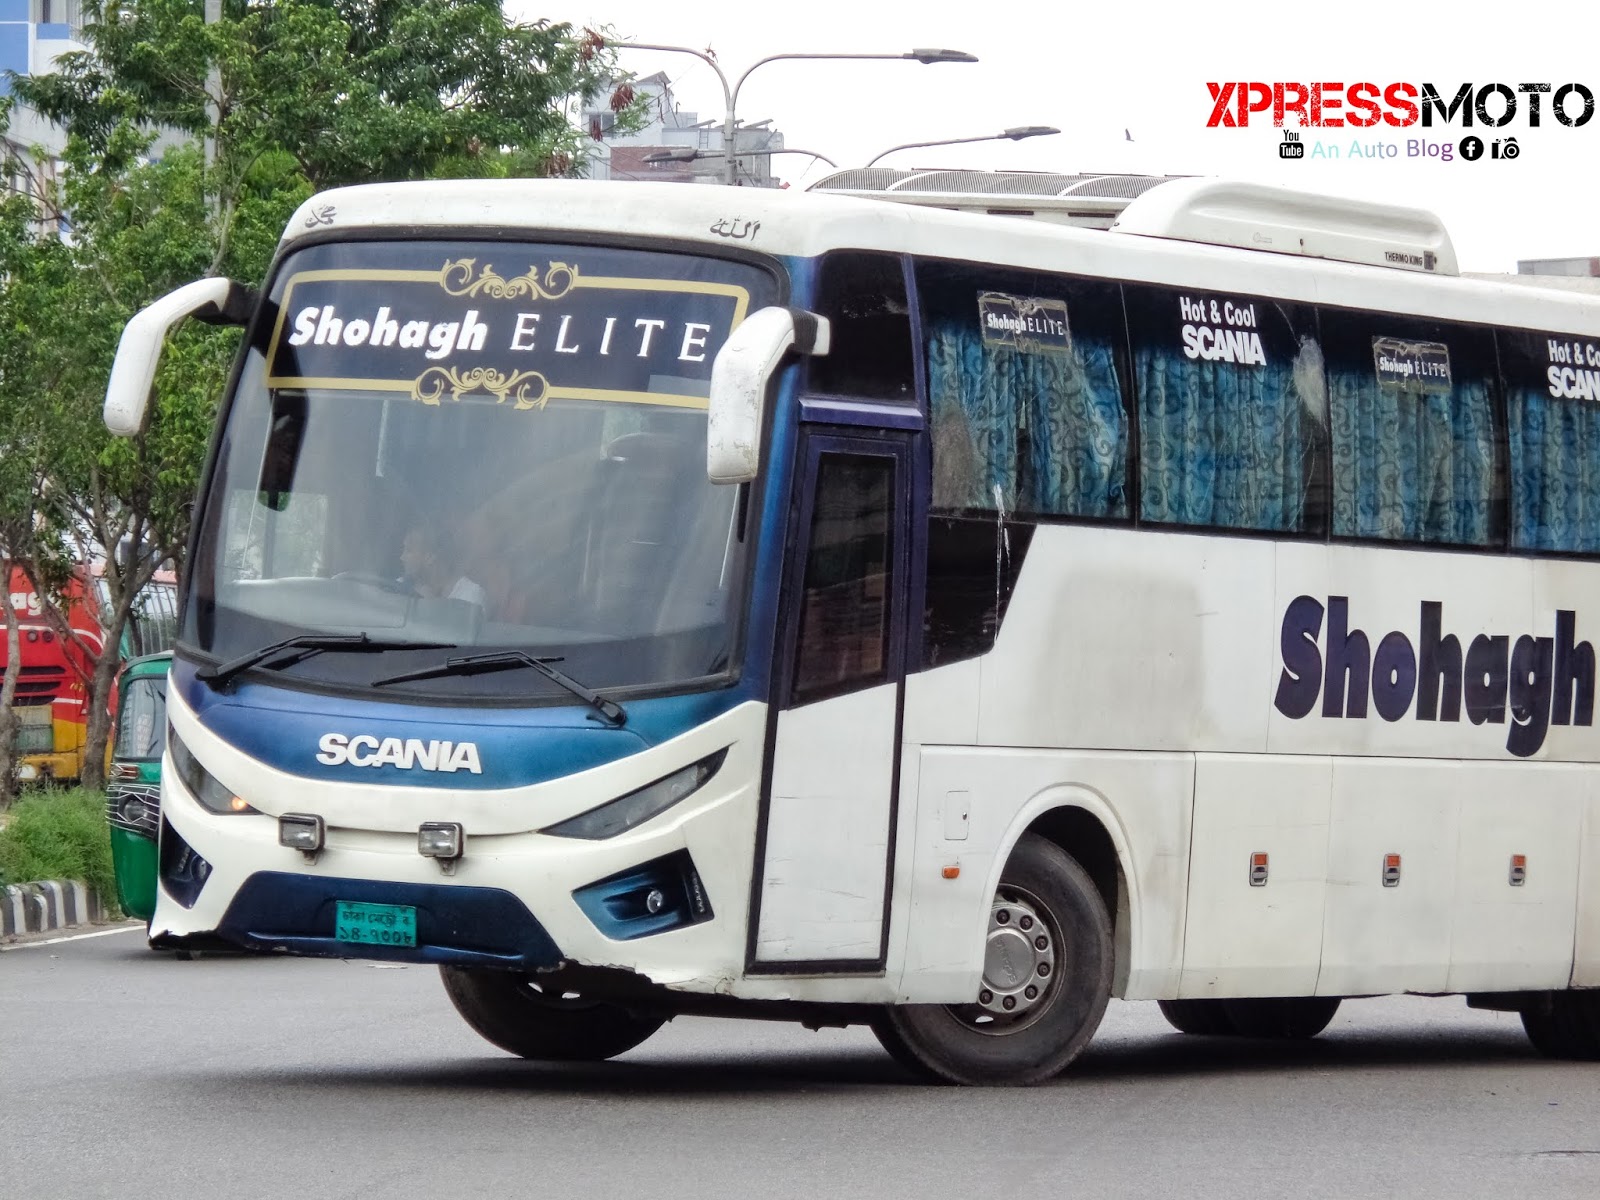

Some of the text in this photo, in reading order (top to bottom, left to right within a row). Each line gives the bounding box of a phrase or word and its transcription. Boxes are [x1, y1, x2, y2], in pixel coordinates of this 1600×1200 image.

[1385, 251, 1423, 266] THERMO KING
[987, 313, 1064, 336] Shohagh ELITE
[1180, 296, 1256, 328] Hot & Cool
[288, 305, 710, 362] Shohagh ELITE
[1182, 324, 1267, 366] SCANIA
[1380, 356, 1446, 377] Shohagh ELITE
[1548, 340, 1571, 364] Hot
[1574, 342, 1584, 365] &
[1273, 595, 1596, 757] Shohagh
[316, 733, 482, 774] SCANIA
